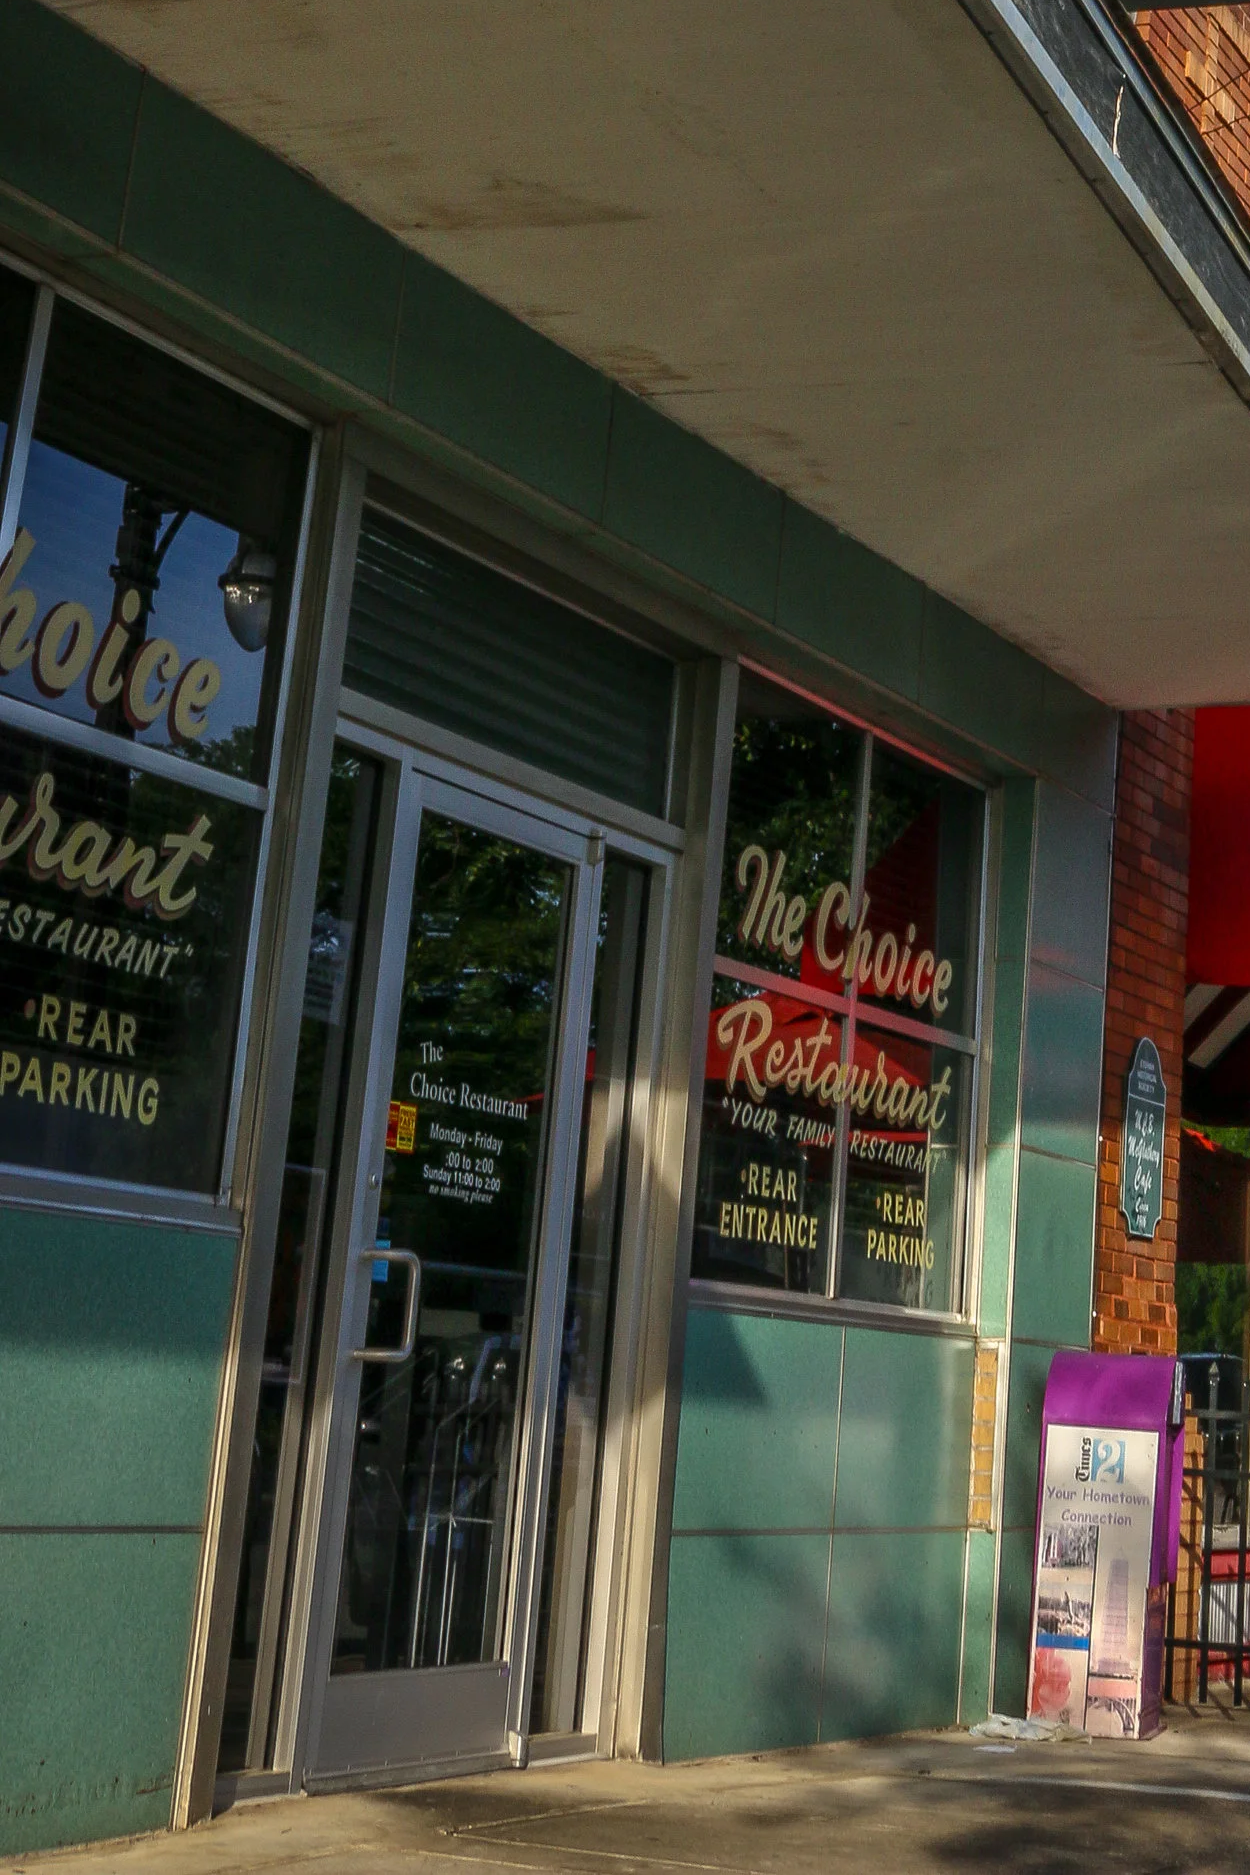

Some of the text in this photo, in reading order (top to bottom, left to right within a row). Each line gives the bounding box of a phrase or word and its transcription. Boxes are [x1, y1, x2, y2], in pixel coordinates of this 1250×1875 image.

[737, 844, 952, 1014] The Choice
[37, 993, 137, 1057] REAR
[420, 1040, 444, 1064] The
[717, 999, 952, 1130] Restaurant
[0, 1051, 160, 1126] PARKING
[410, 1071, 528, 1121] Choice Restaurant
[429, 1122, 467, 1149] Monday
[474, 1131, 503, 1156] Friday
[786, 1114, 836, 1150] FAMILY
[423, 1163, 501, 1192] Sunday 11:00 to 2:00
[462, 1157, 471, 1171] to
[475, 1158, 494, 1175] 2:00
[747, 1163, 797, 1202] REAR
[428, 1183, 494, 1204] no smoking please
[883, 1191, 925, 1228] REAR
[719, 1201, 818, 1250] ENTRANCE
[867, 1229, 935, 1270] PARKING
[1075, 1437, 1121, 1483] Times 2
[1047, 1486, 1150, 1505] Your Hometown
[1061, 1509, 1132, 1526] Connection
